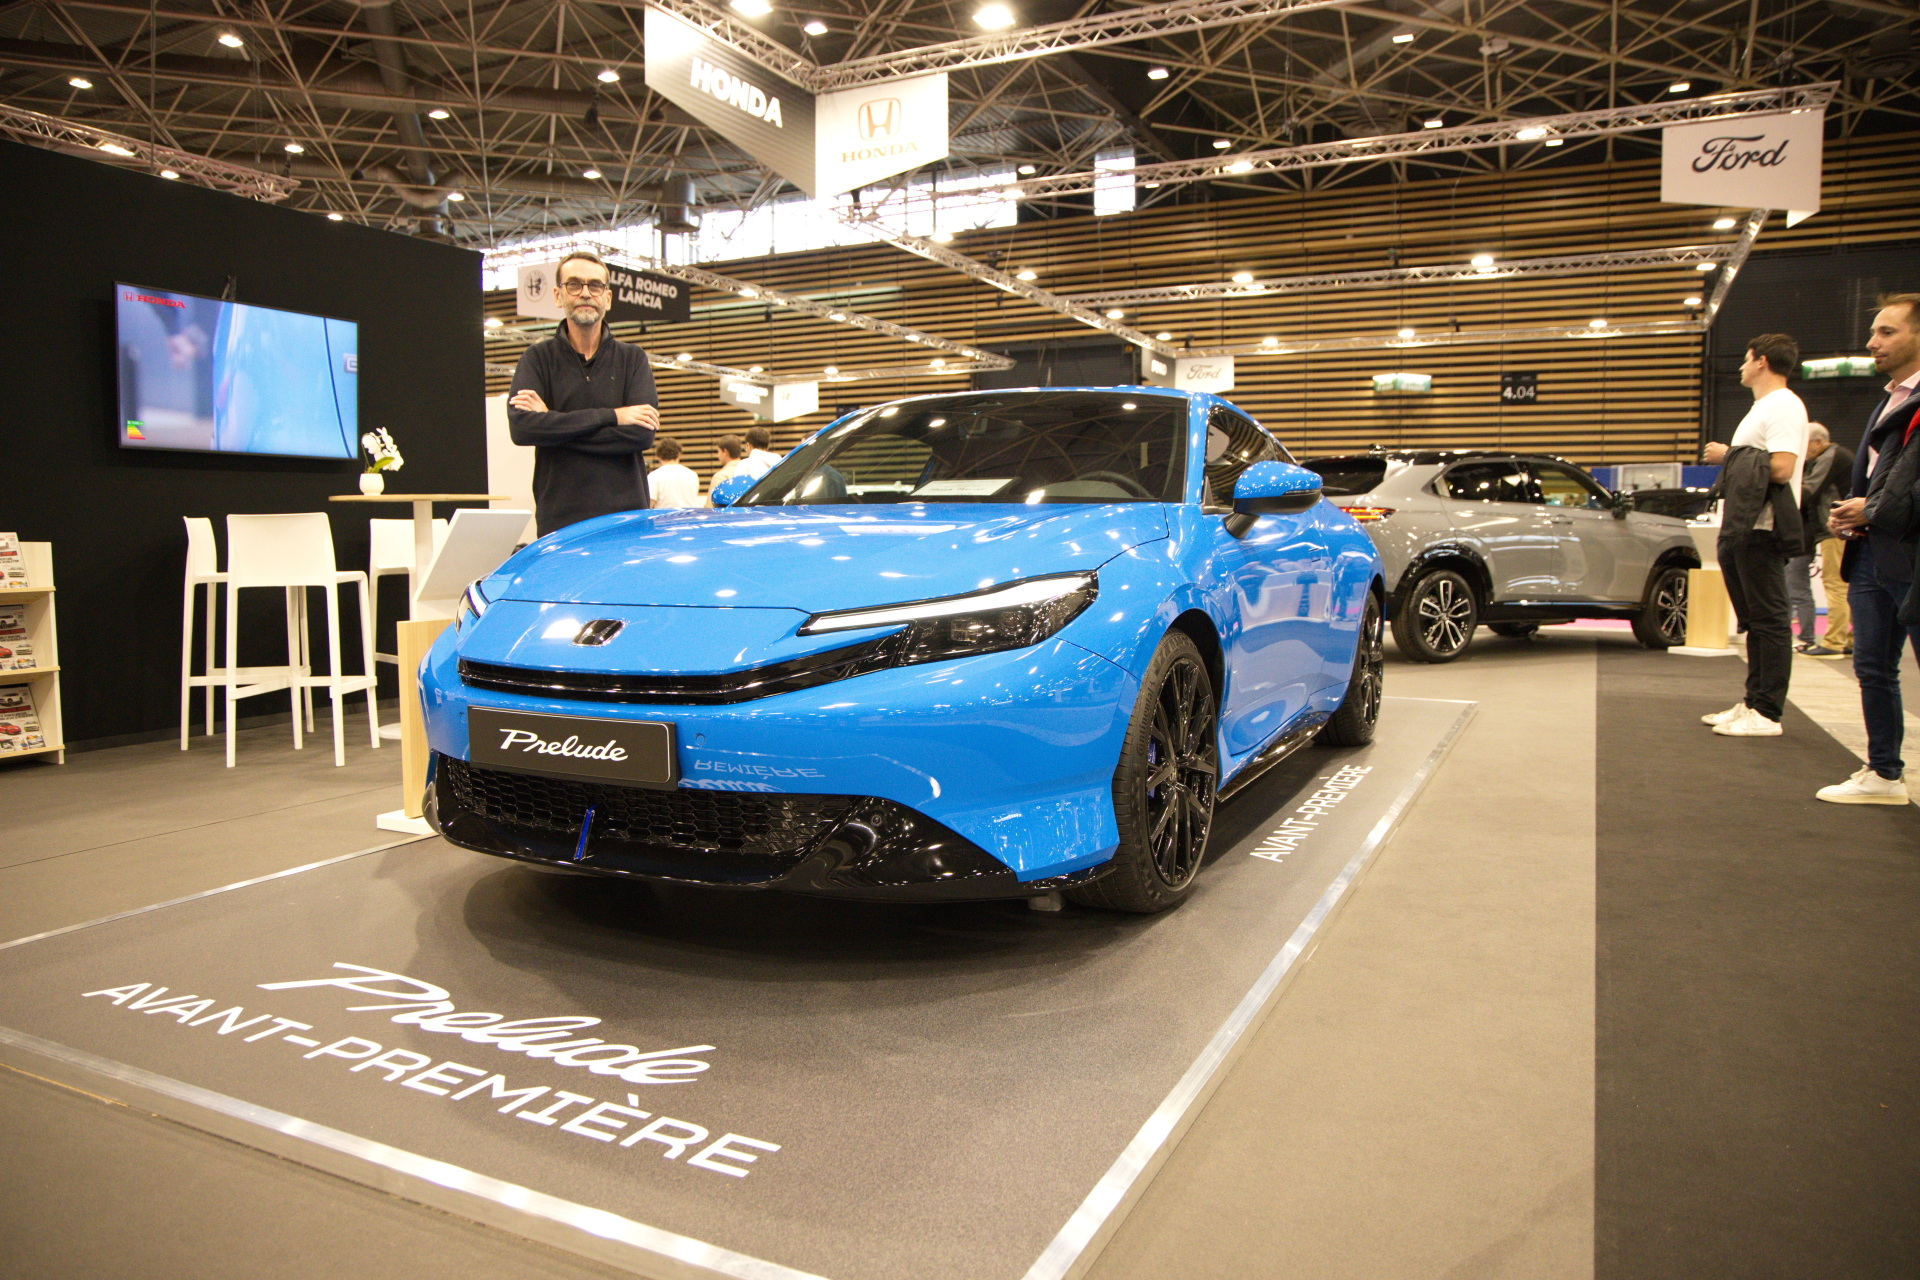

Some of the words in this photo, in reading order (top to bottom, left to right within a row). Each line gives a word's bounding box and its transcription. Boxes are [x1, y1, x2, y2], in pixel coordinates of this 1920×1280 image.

[690, 57, 783, 128] HONDA
[841, 142, 919, 163] HONDA
[1692, 134, 1790, 172] Ford
[136, 294, 186, 309] HONDA
[609, 270, 634, 289] LFA
[635, 276, 678, 299] ROMEO
[618, 288, 663, 310] LANCIA
[1187, 364, 1222, 380] Ford
[1502, 385, 1536, 400] 4.04
[1136, 686, 1156, 757] Continental
[499, 728, 628, 762] Prelude
[1250, 764, 1373, 863] AVANT-PREMIÈRE
[257, 962, 717, 1084] Prelude
[81, 982, 782, 1178] AVANT-PREMIÈRE
